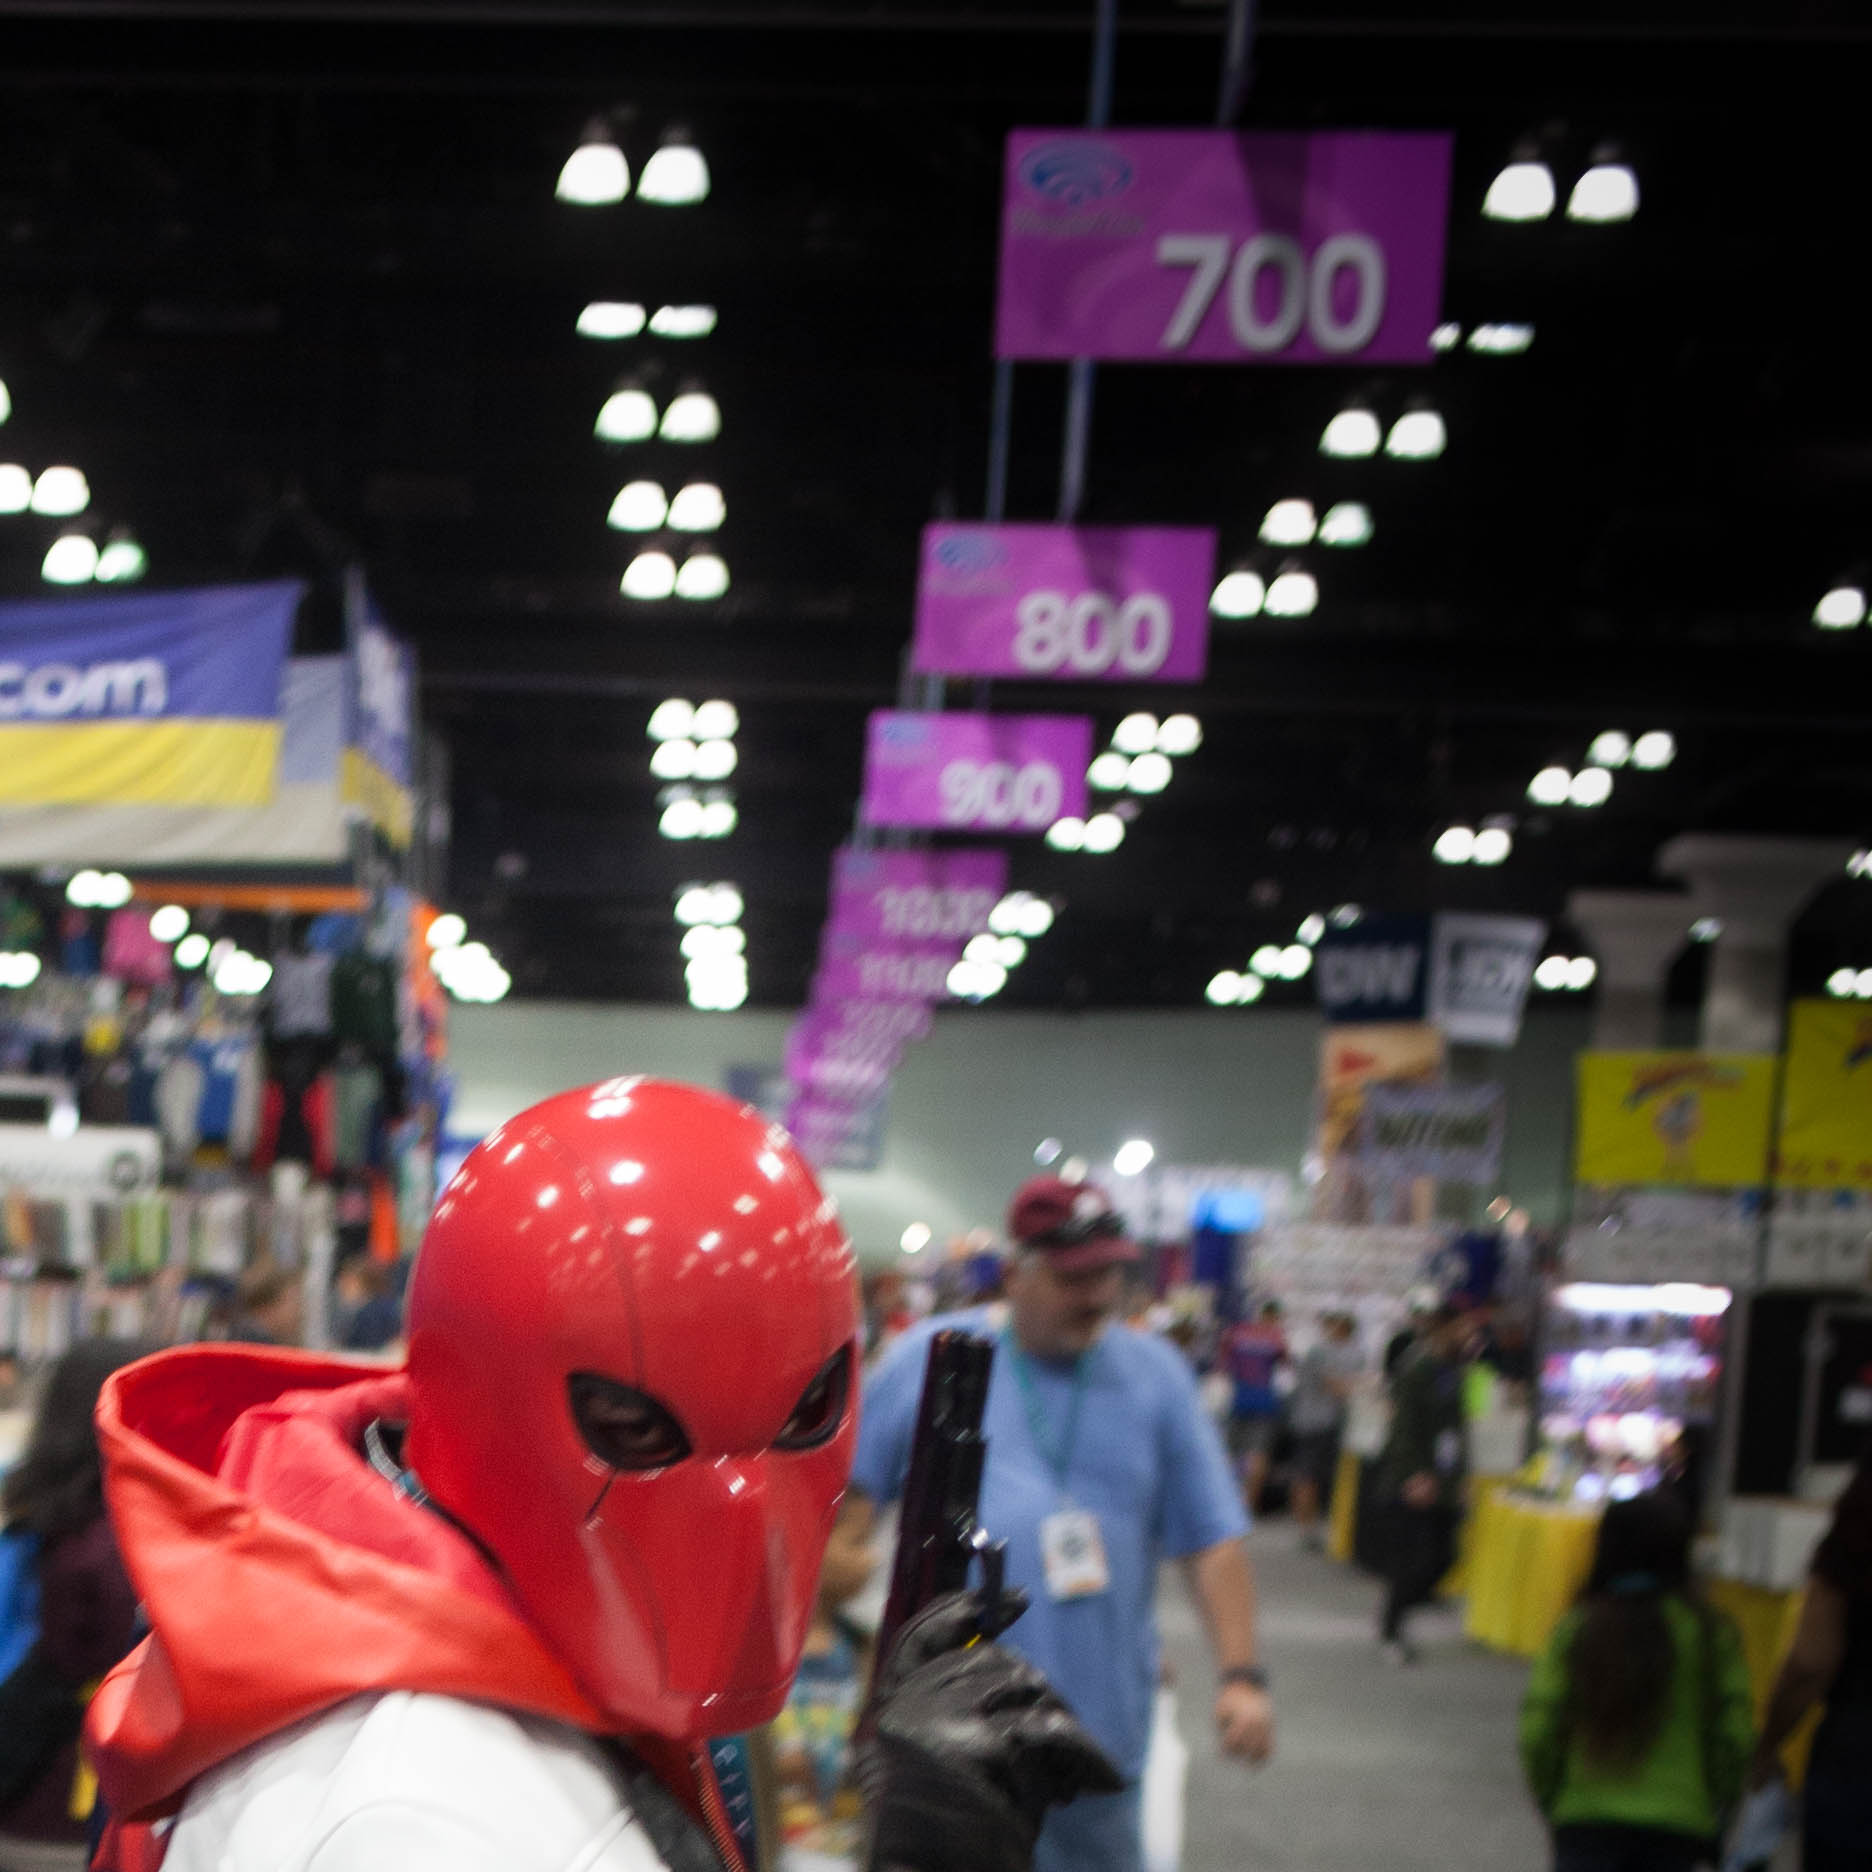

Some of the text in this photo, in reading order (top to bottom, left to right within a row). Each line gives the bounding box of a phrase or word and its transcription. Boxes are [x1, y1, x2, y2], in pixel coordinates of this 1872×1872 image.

[1155, 234, 1384, 352] 700
[1012, 591, 1172, 677] 800
[939, 762, 1063, 826] 900
